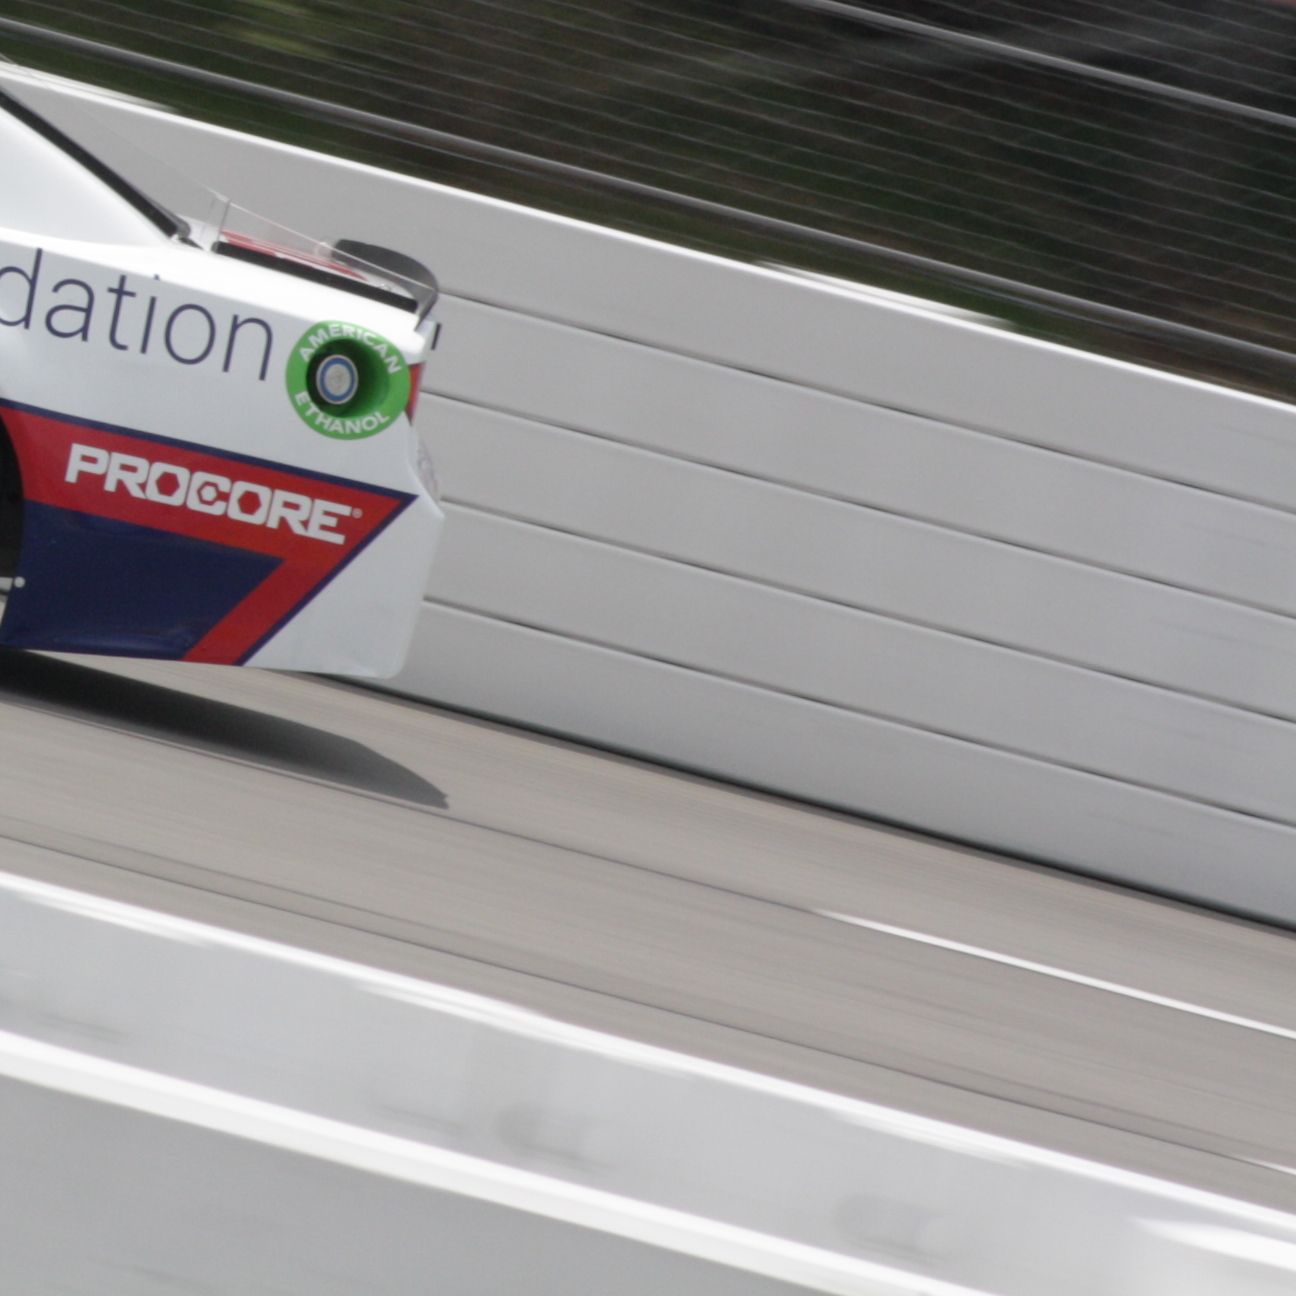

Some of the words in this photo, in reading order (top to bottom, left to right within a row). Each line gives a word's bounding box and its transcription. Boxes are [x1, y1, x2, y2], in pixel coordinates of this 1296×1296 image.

[298, 323, 403, 375] AMERICAN
[294, 391, 391, 435] ETHANOL
[64, 442, 353, 545] PROCORE
